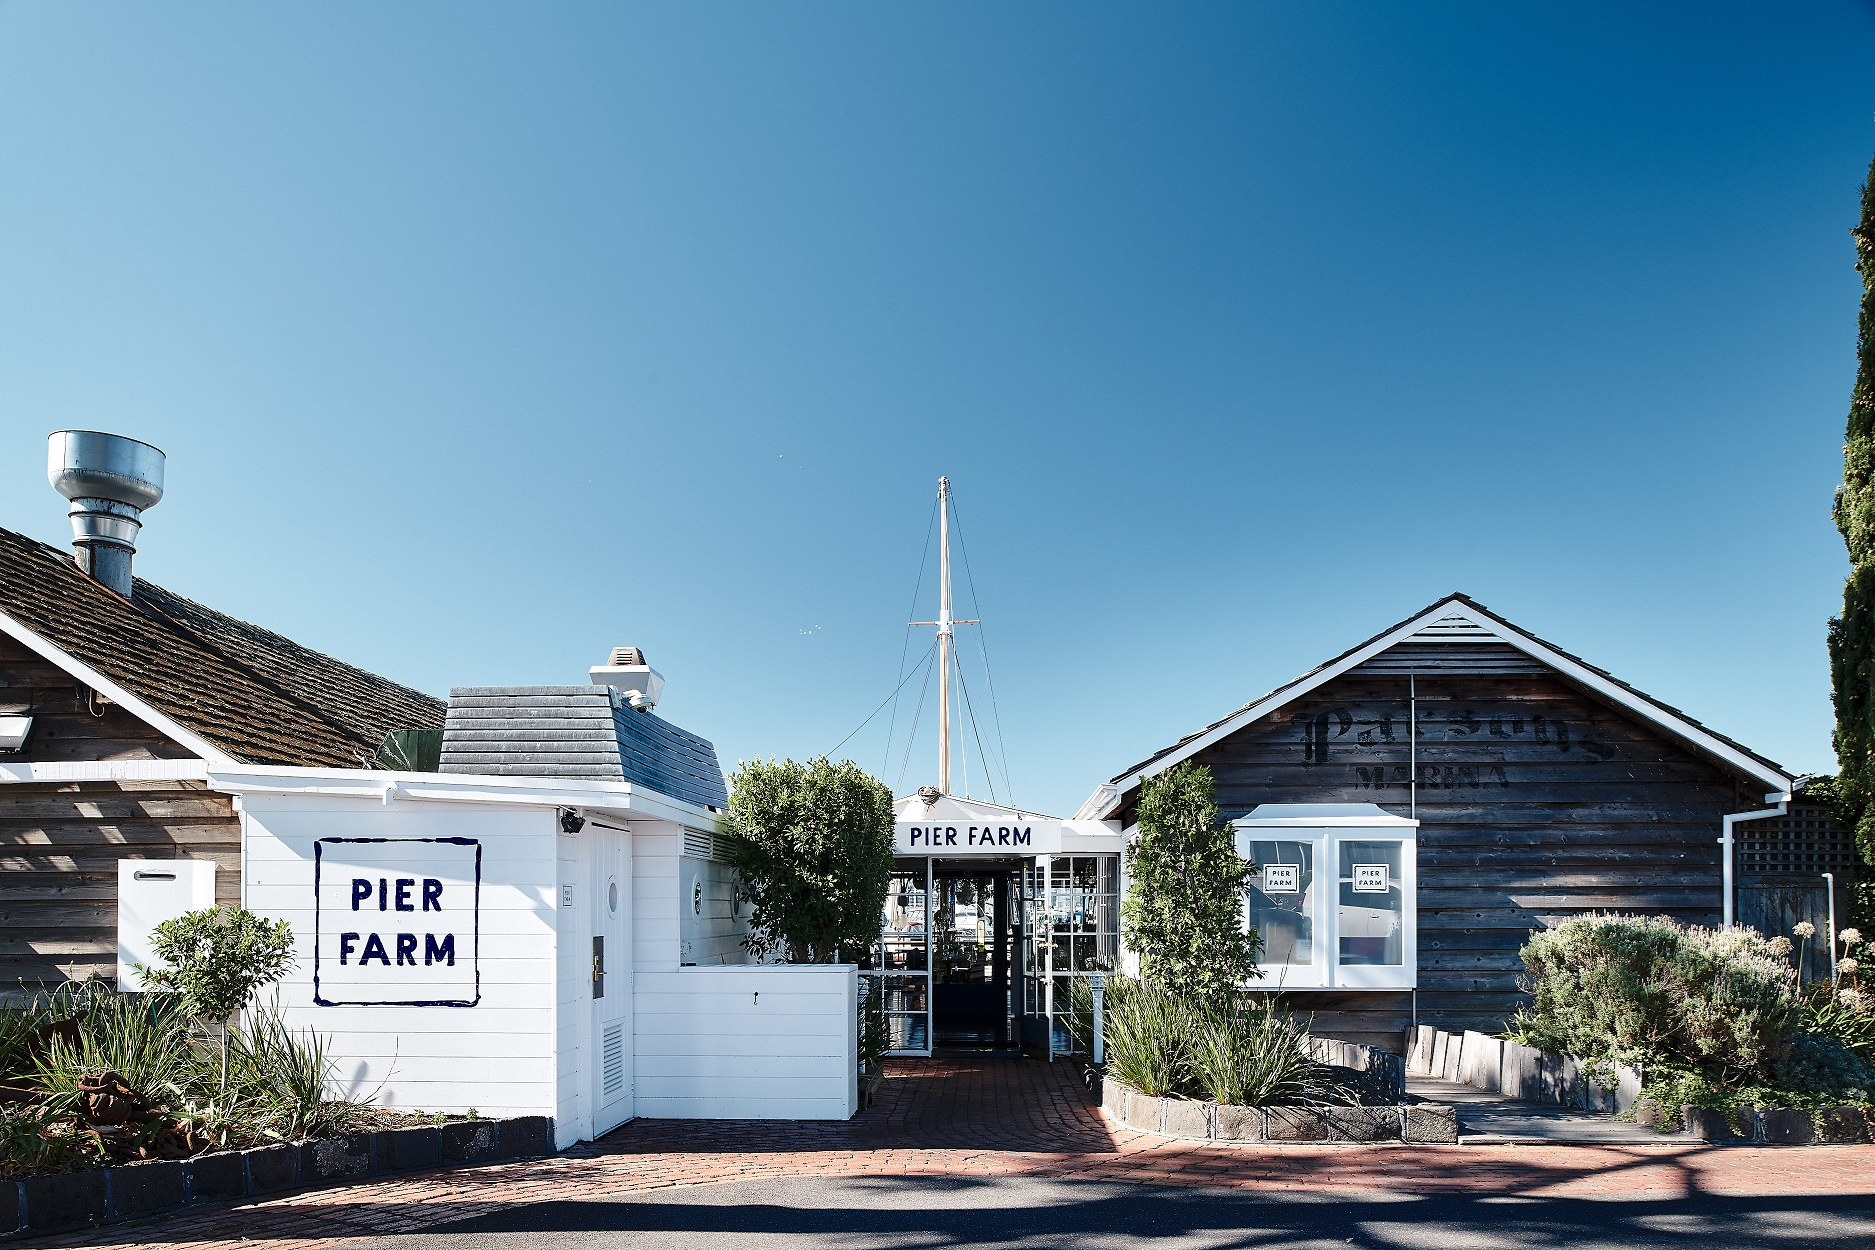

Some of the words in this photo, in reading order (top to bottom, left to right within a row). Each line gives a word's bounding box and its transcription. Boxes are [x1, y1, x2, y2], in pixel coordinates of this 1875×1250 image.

[1354, 765, 1511, 790] MARINA
[910, 826, 958, 847] PIER
[968, 826, 1032, 847] FARM
[351, 878, 444, 912] PIER
[340, 932, 455, 967] FARM
